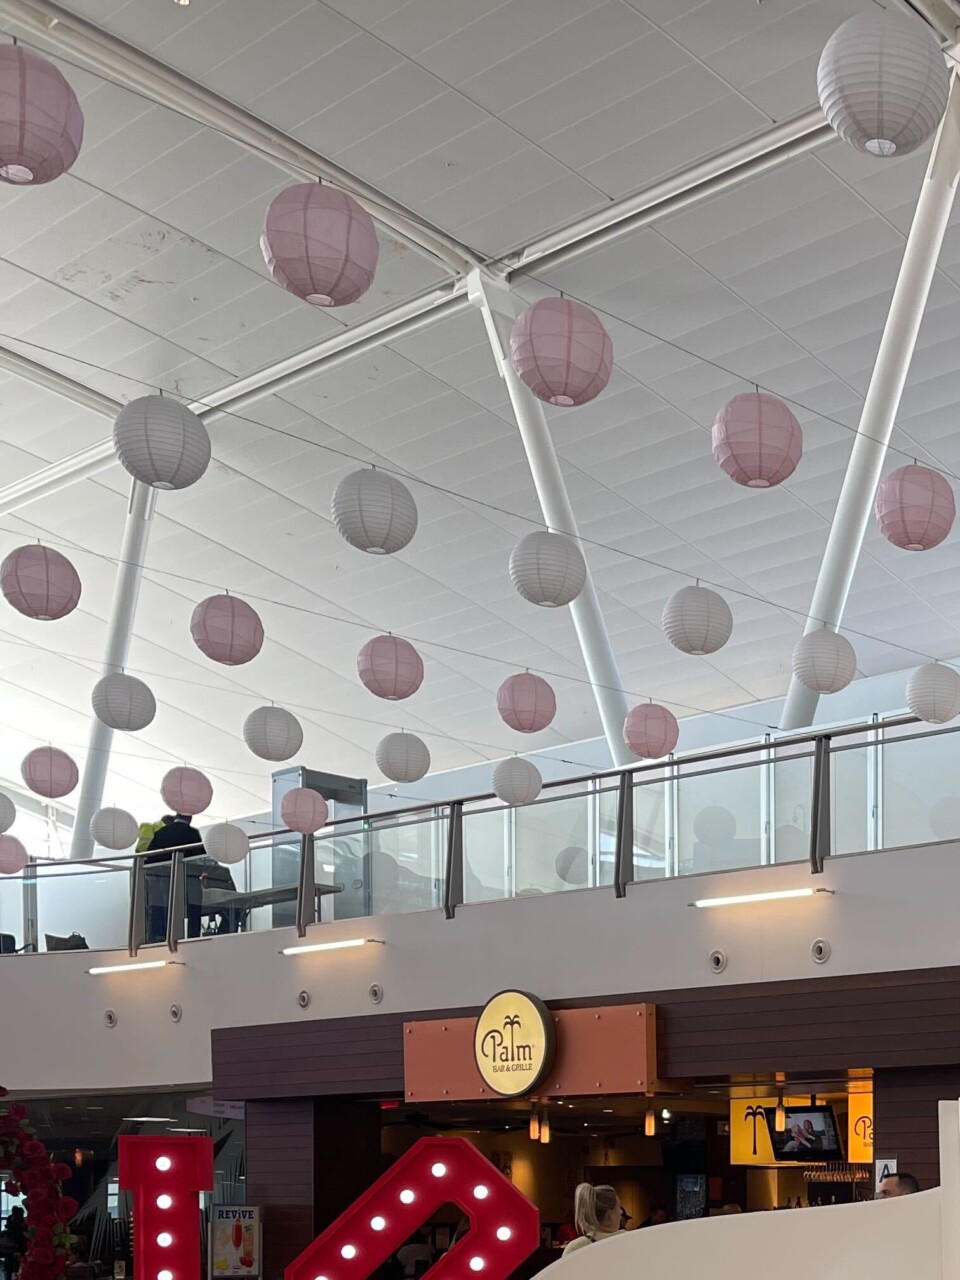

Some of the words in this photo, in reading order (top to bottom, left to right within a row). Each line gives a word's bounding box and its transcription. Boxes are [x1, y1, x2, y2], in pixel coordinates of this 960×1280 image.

[481, 1015, 533, 1063] Palm
[492, 1065, 506, 1073] BAR
[511, 1063, 533, 1072] GRILLE
[854, 1115, 874, 1140] Pa
[879, 1163, 892, 1184] A
